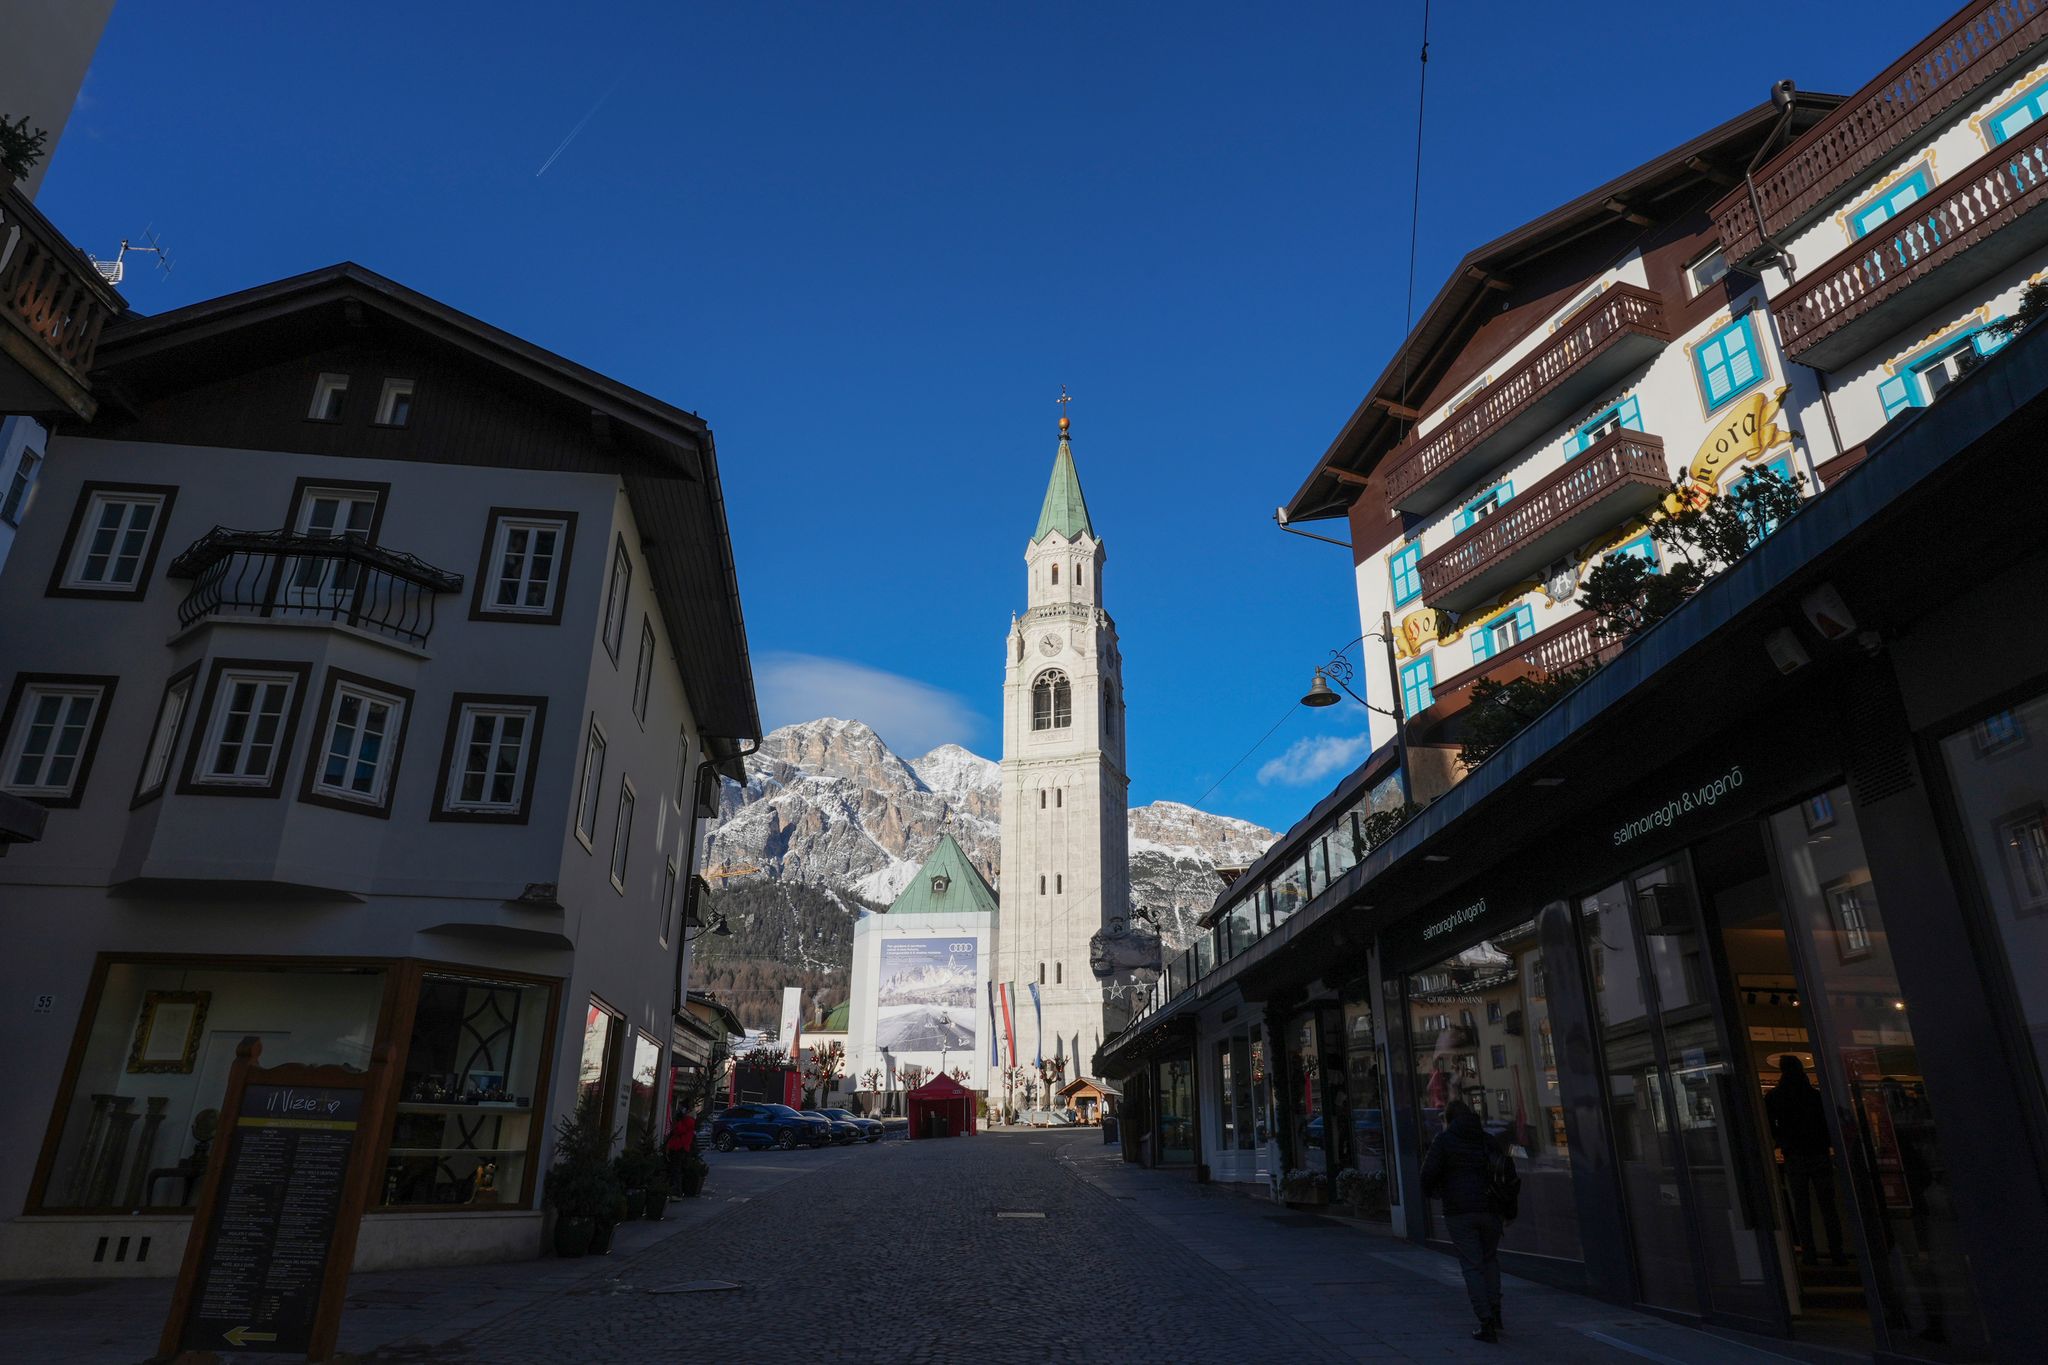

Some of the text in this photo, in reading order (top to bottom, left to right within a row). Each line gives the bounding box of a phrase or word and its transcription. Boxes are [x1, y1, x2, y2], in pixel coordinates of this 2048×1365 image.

[1613, 800, 1683, 846] salmoiraghi
[1682, 792, 1695, 812] &
[1422, 913, 1457, 941] salmoiraghi
[38, 996, 53, 1008] 55
[1427, 996, 1483, 1004] GIORGIO ARMANI
